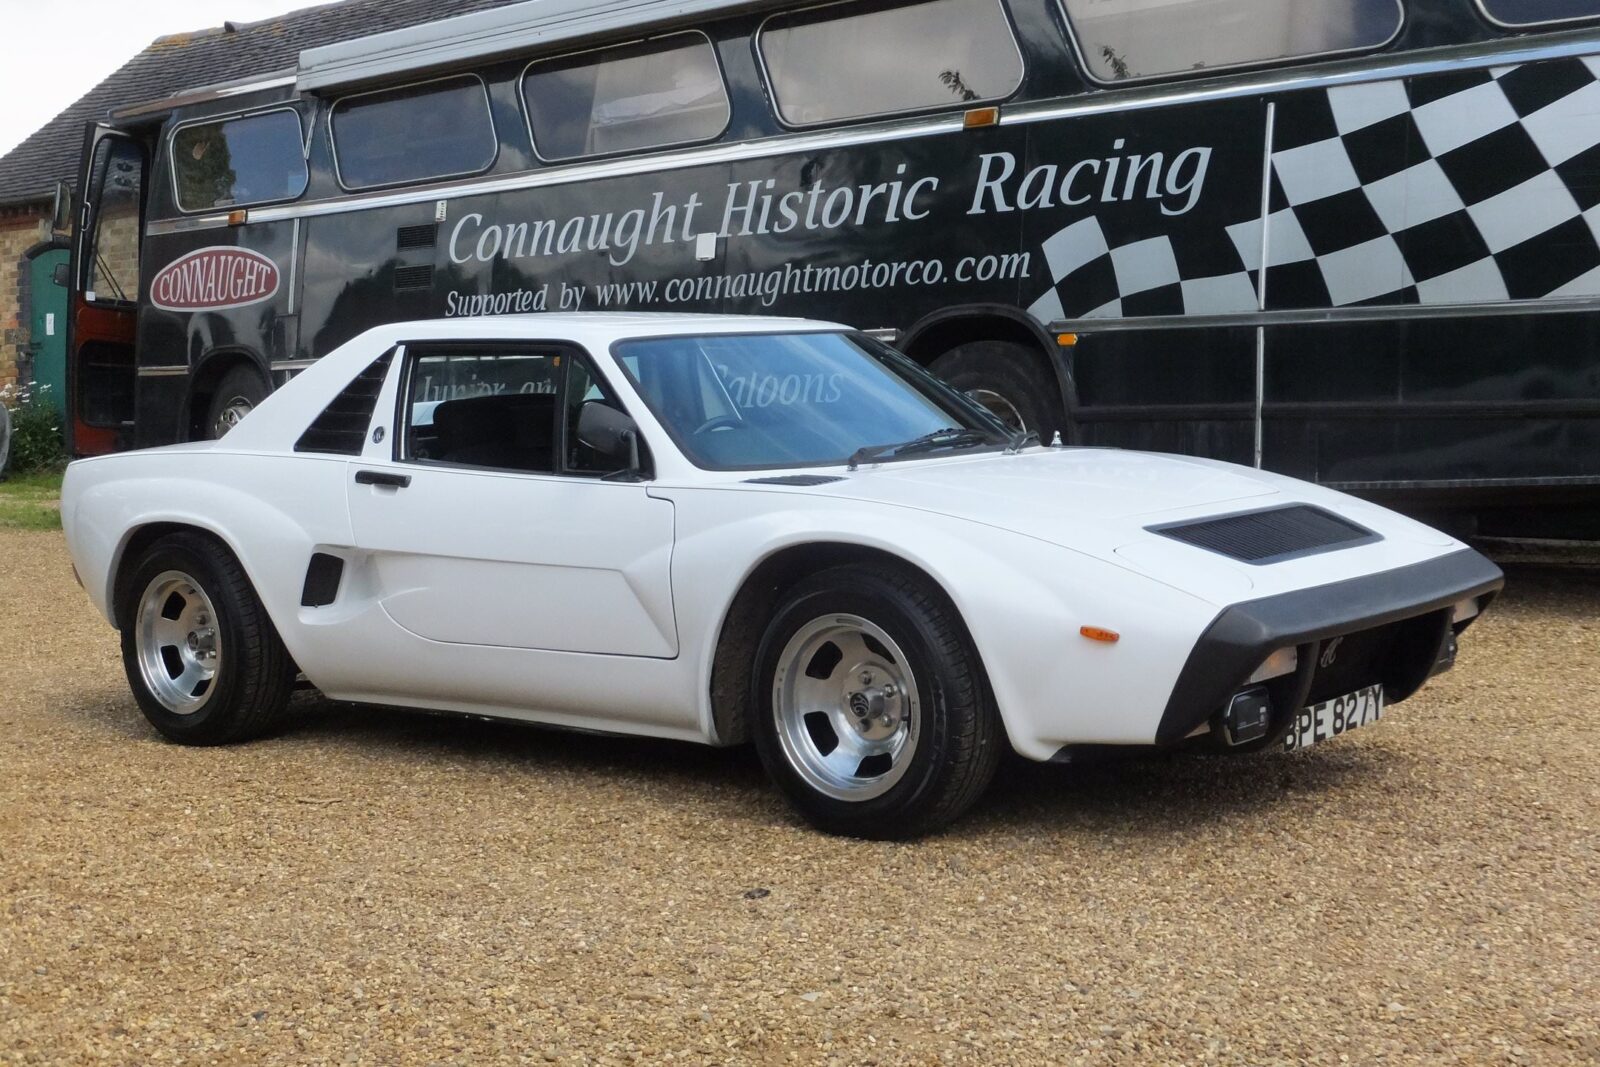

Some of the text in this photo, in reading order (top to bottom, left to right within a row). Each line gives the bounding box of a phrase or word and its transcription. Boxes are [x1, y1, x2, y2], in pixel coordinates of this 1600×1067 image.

[449, 138, 1213, 267] Connaught Historic Racing
[159, 255, 271, 303] CONNAUGHT
[445, 283, 549, 317] Supported
[559, 282, 586, 312] by
[716, 364, 842, 408] aloons
[1332, 683, 1383, 735] 827Y
